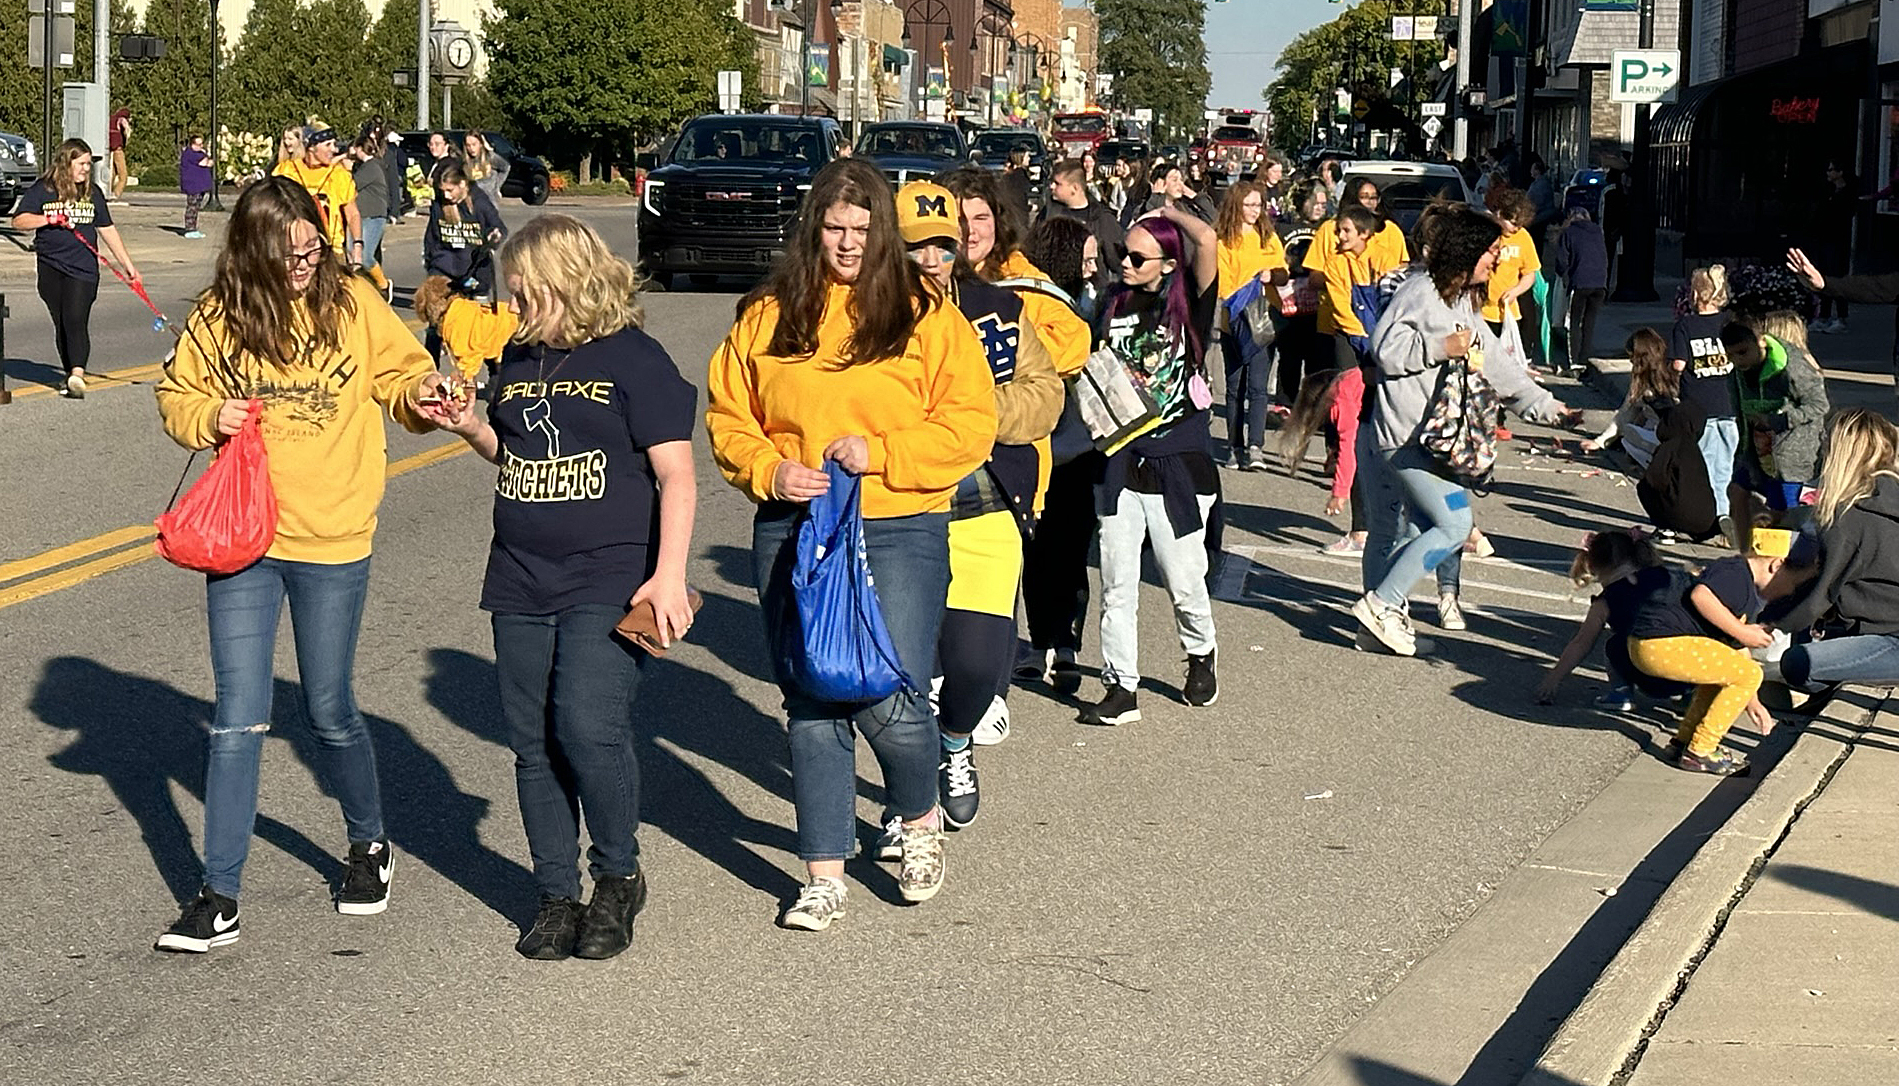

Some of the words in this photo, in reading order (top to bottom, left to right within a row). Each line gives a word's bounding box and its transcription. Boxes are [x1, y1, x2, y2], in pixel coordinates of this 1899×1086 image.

[1425, 105, 1441, 113] EAST
[914, 194, 949, 218] M
[552, 381, 614, 405] AXE
